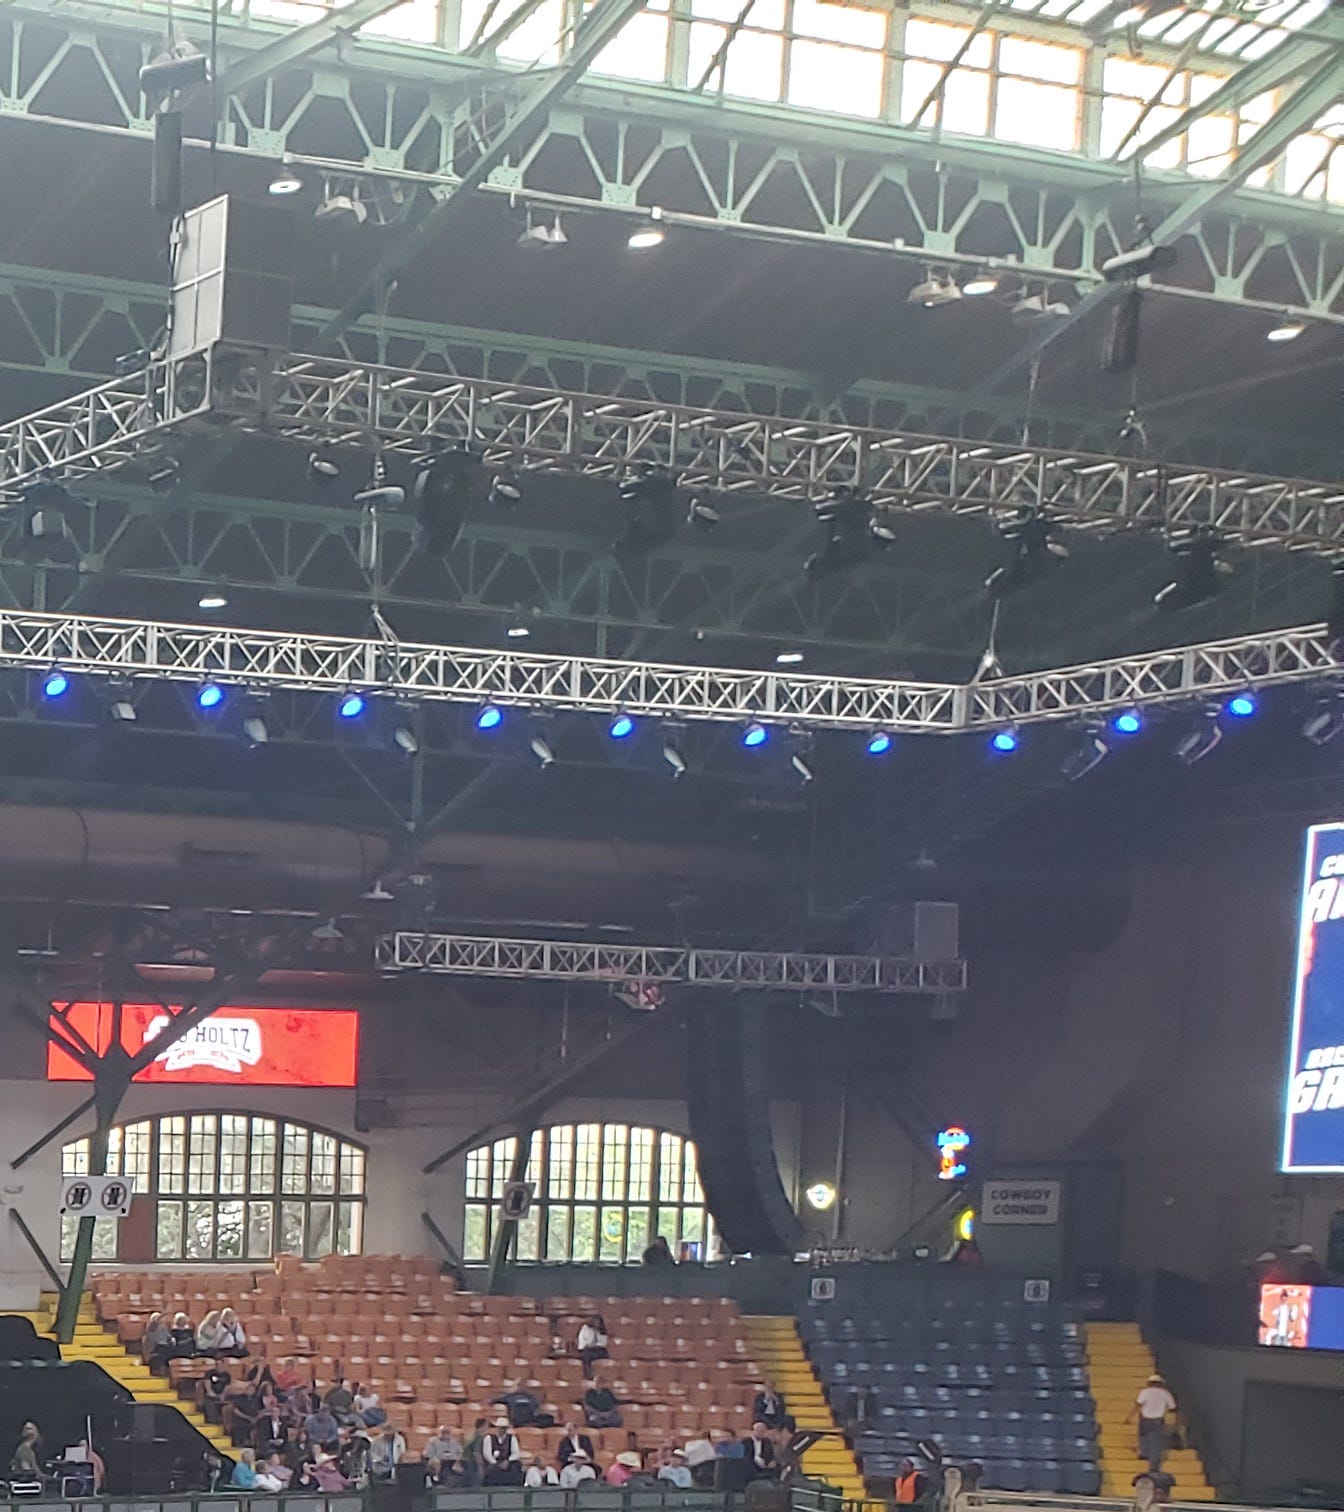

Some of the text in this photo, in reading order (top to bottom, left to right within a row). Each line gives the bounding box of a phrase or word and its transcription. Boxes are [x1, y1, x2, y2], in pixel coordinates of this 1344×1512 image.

[195, 1026, 251, 1053] HOLTZ
[991, 1190, 1052, 1201] COWBOY
[993, 1205, 1048, 1216] CORNER
